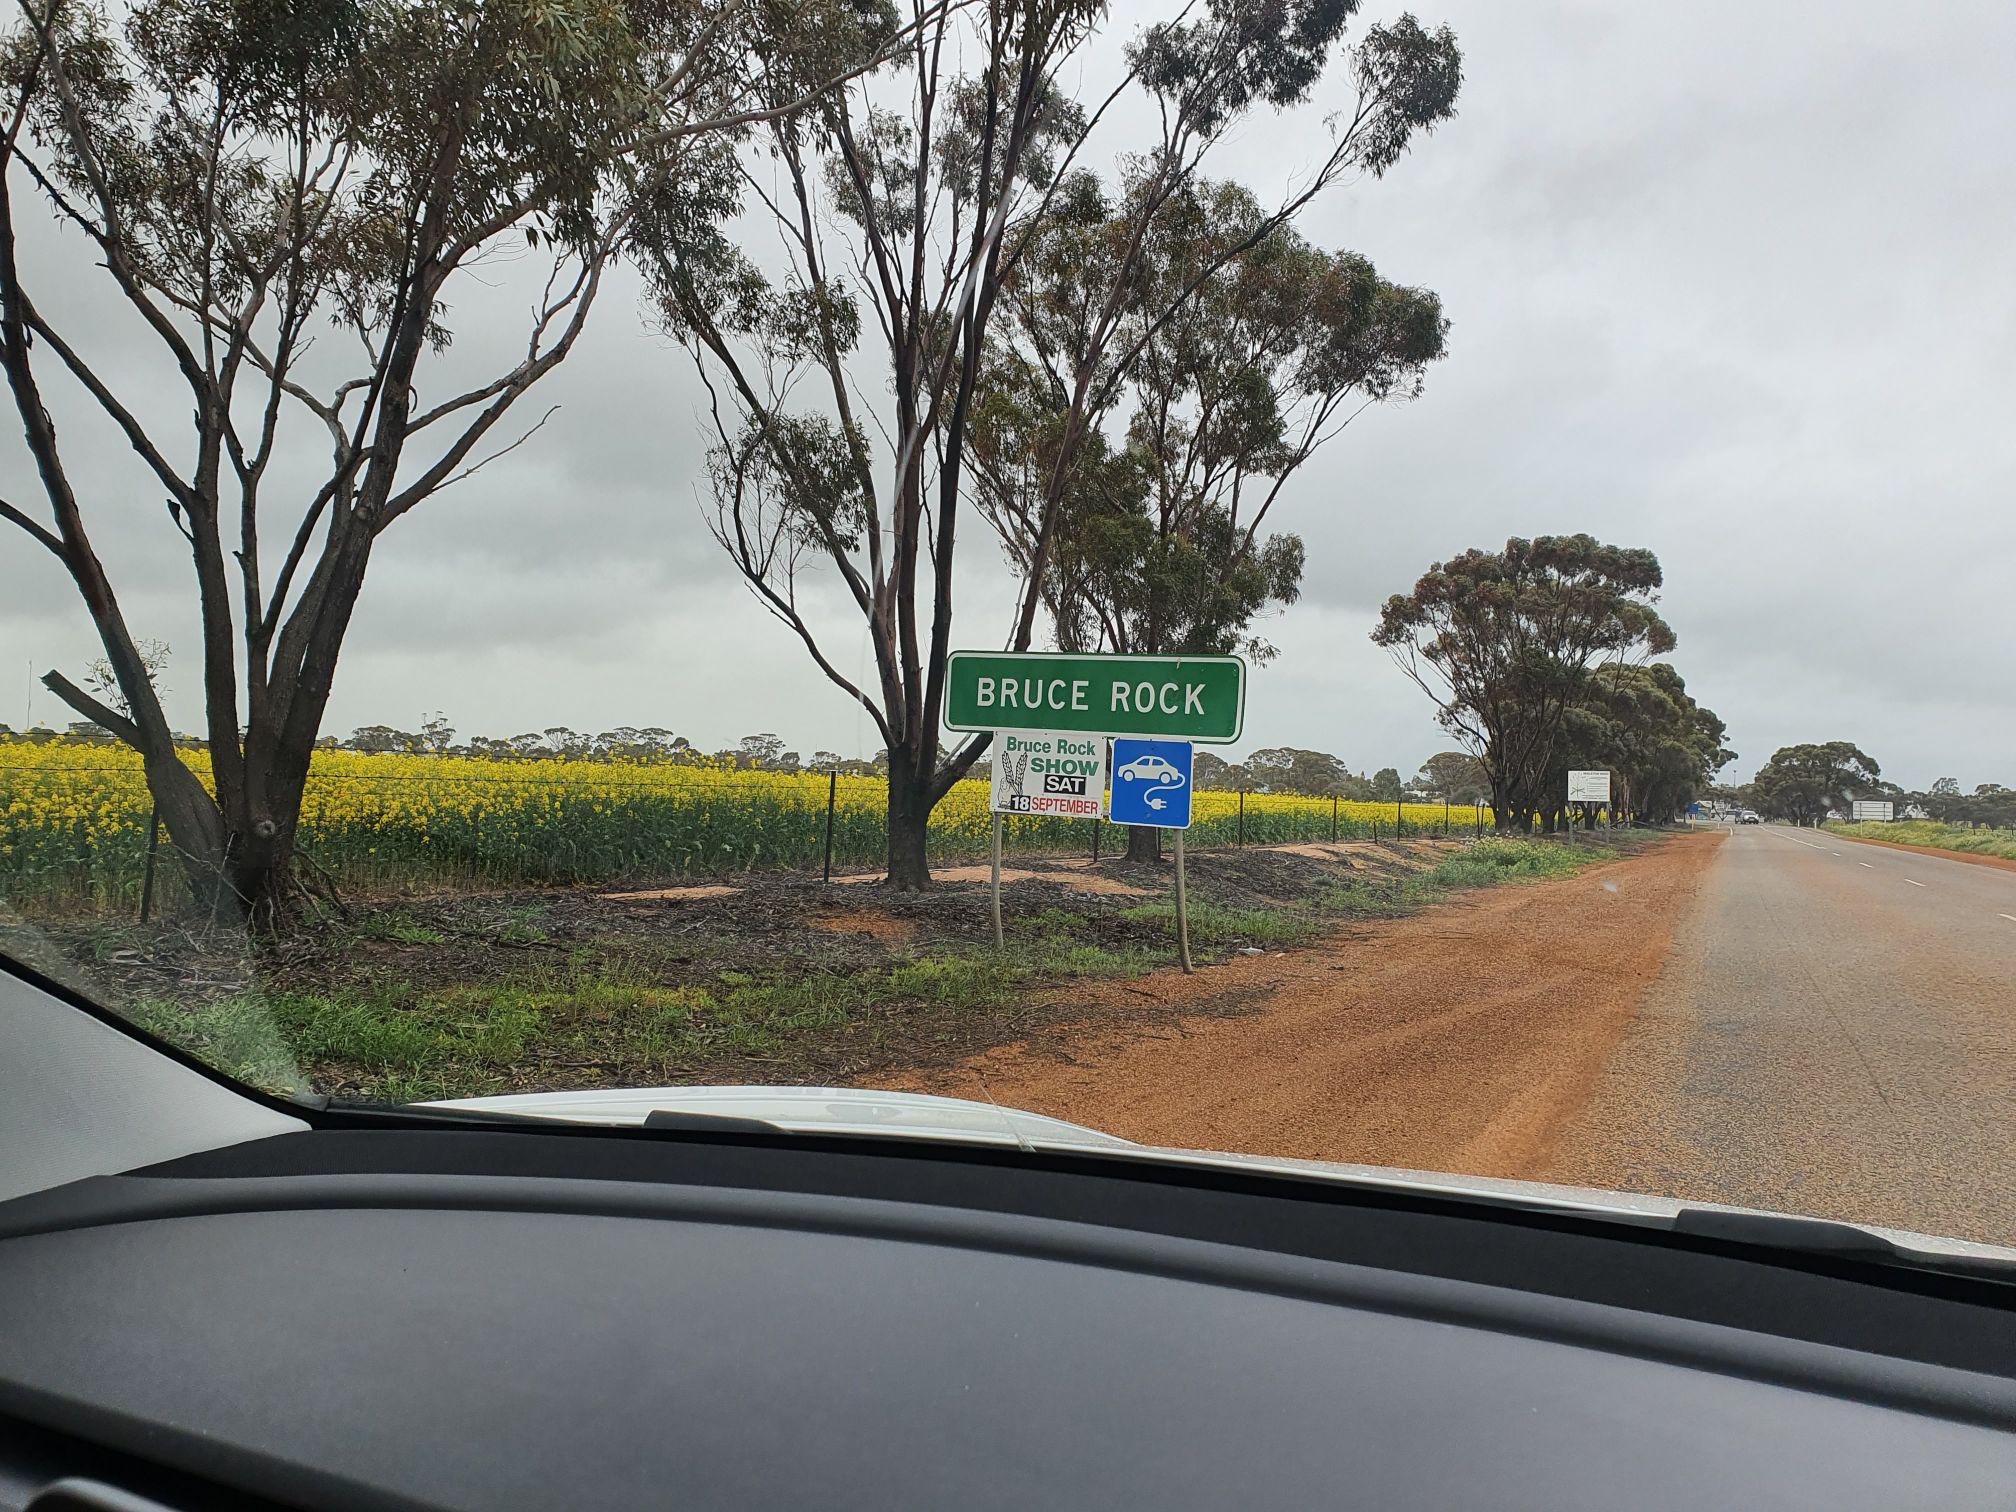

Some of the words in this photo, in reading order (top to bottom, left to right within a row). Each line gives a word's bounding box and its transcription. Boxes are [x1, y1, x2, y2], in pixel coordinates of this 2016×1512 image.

[976, 677, 1089, 710] BRUCE
[1110, 681, 1206, 715] ROCK
[1006, 736, 1051, 753] Bruce
[1057, 739, 1096, 756] Rock
[1030, 757, 1099, 776] SHOW
[1046, 776, 1084, 793] SAT
[1012, 796, 1030, 811] 18
[1031, 797, 1098, 814] SEPTEMBER
